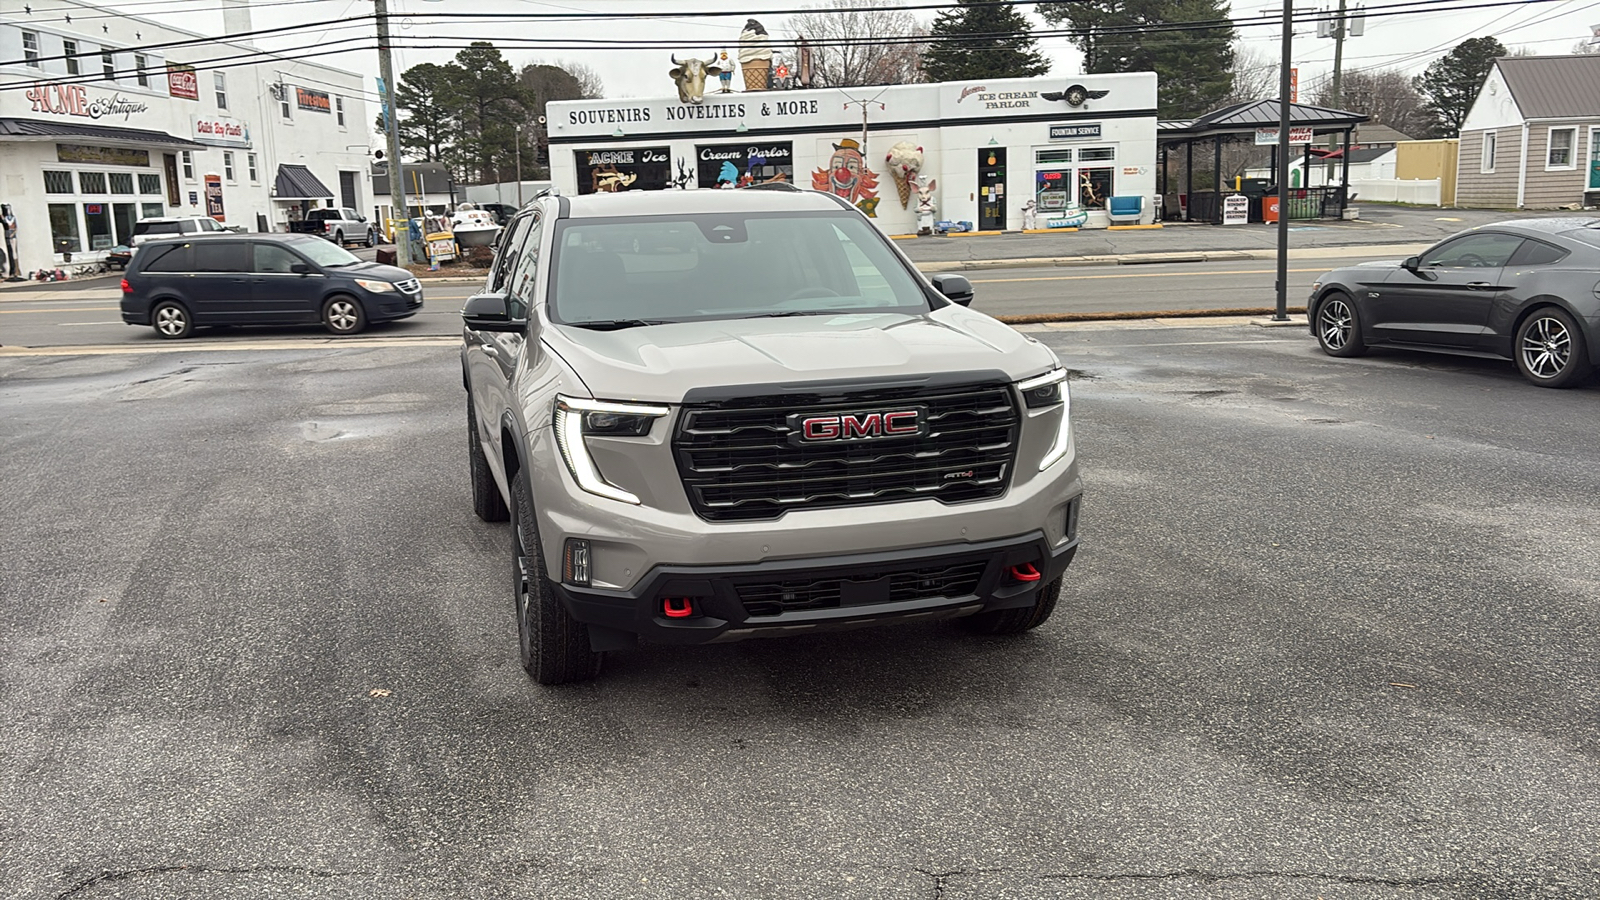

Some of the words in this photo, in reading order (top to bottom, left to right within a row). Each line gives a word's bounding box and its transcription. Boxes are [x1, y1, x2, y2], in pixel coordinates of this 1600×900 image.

[26, 82, 89, 117] ACME
[978, 93, 996, 101] ICE
[998, 91, 1038, 100] CREAM
[985, 100, 1030, 109] PARLOR
[569, 107, 651, 125] SOUVENIRS
[666, 103, 746, 121] NOVELTIES
[761, 102, 771, 117] &
[777, 100, 818, 117] MORE
[214, 122, 225, 138] Boy
[1051, 127, 1077, 136] FOUNTAIN
[1078, 126, 1100, 134] SERVICE
[590, 151, 634, 164] ACME
[642, 151, 668, 163] Ice
[700, 148, 742, 161] Cream
[747, 146, 790, 159] Parlor
[803, 410, 918, 440] GMC
